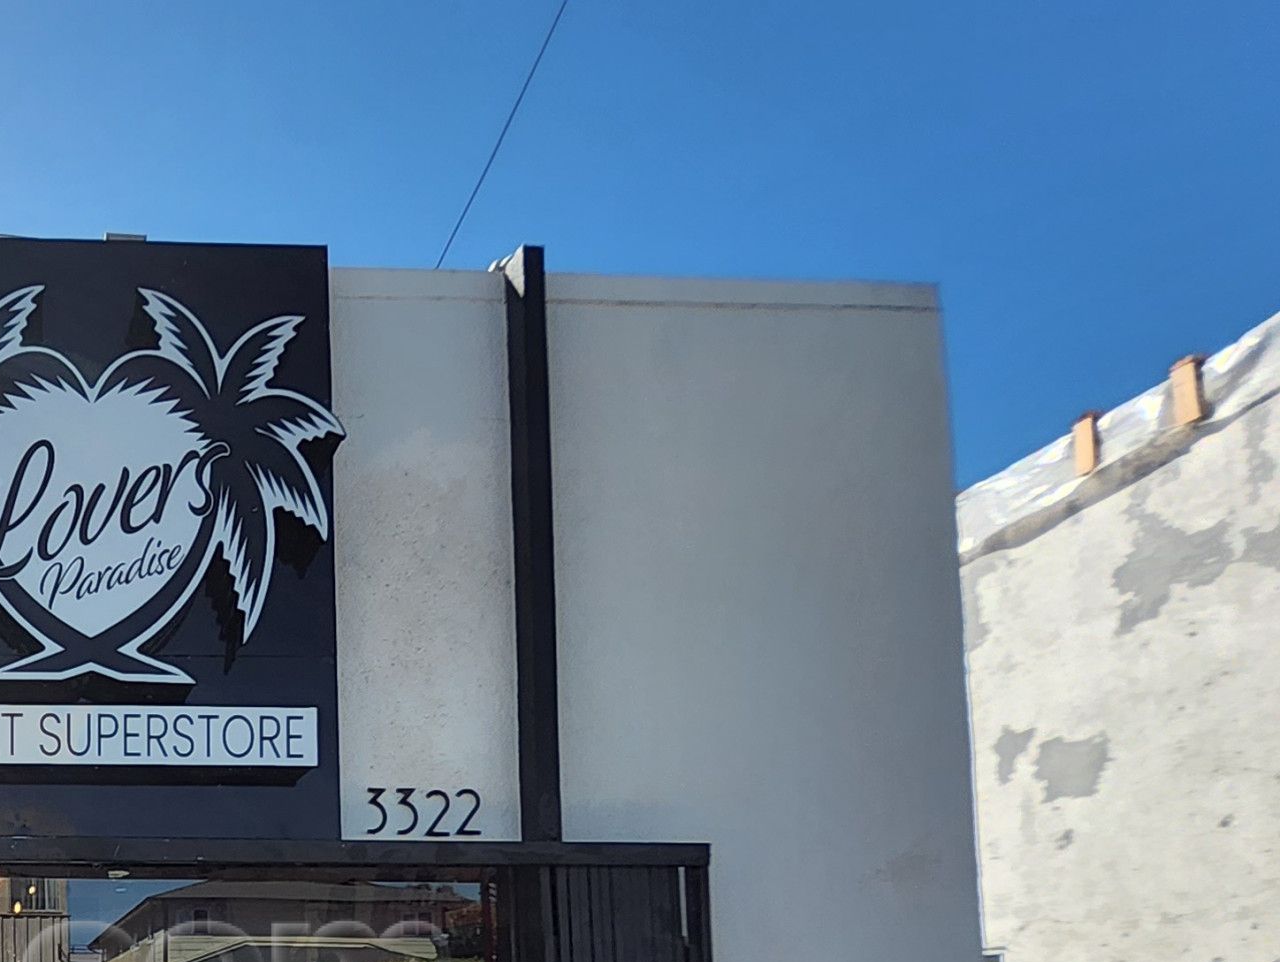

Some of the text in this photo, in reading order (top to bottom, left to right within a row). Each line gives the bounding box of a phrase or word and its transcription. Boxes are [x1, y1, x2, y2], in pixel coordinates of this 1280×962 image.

[40, 537, 185, 610] Paradise
[39, 713, 305, 760] SUPERSTORE
[366, 787, 482, 837] 3322
